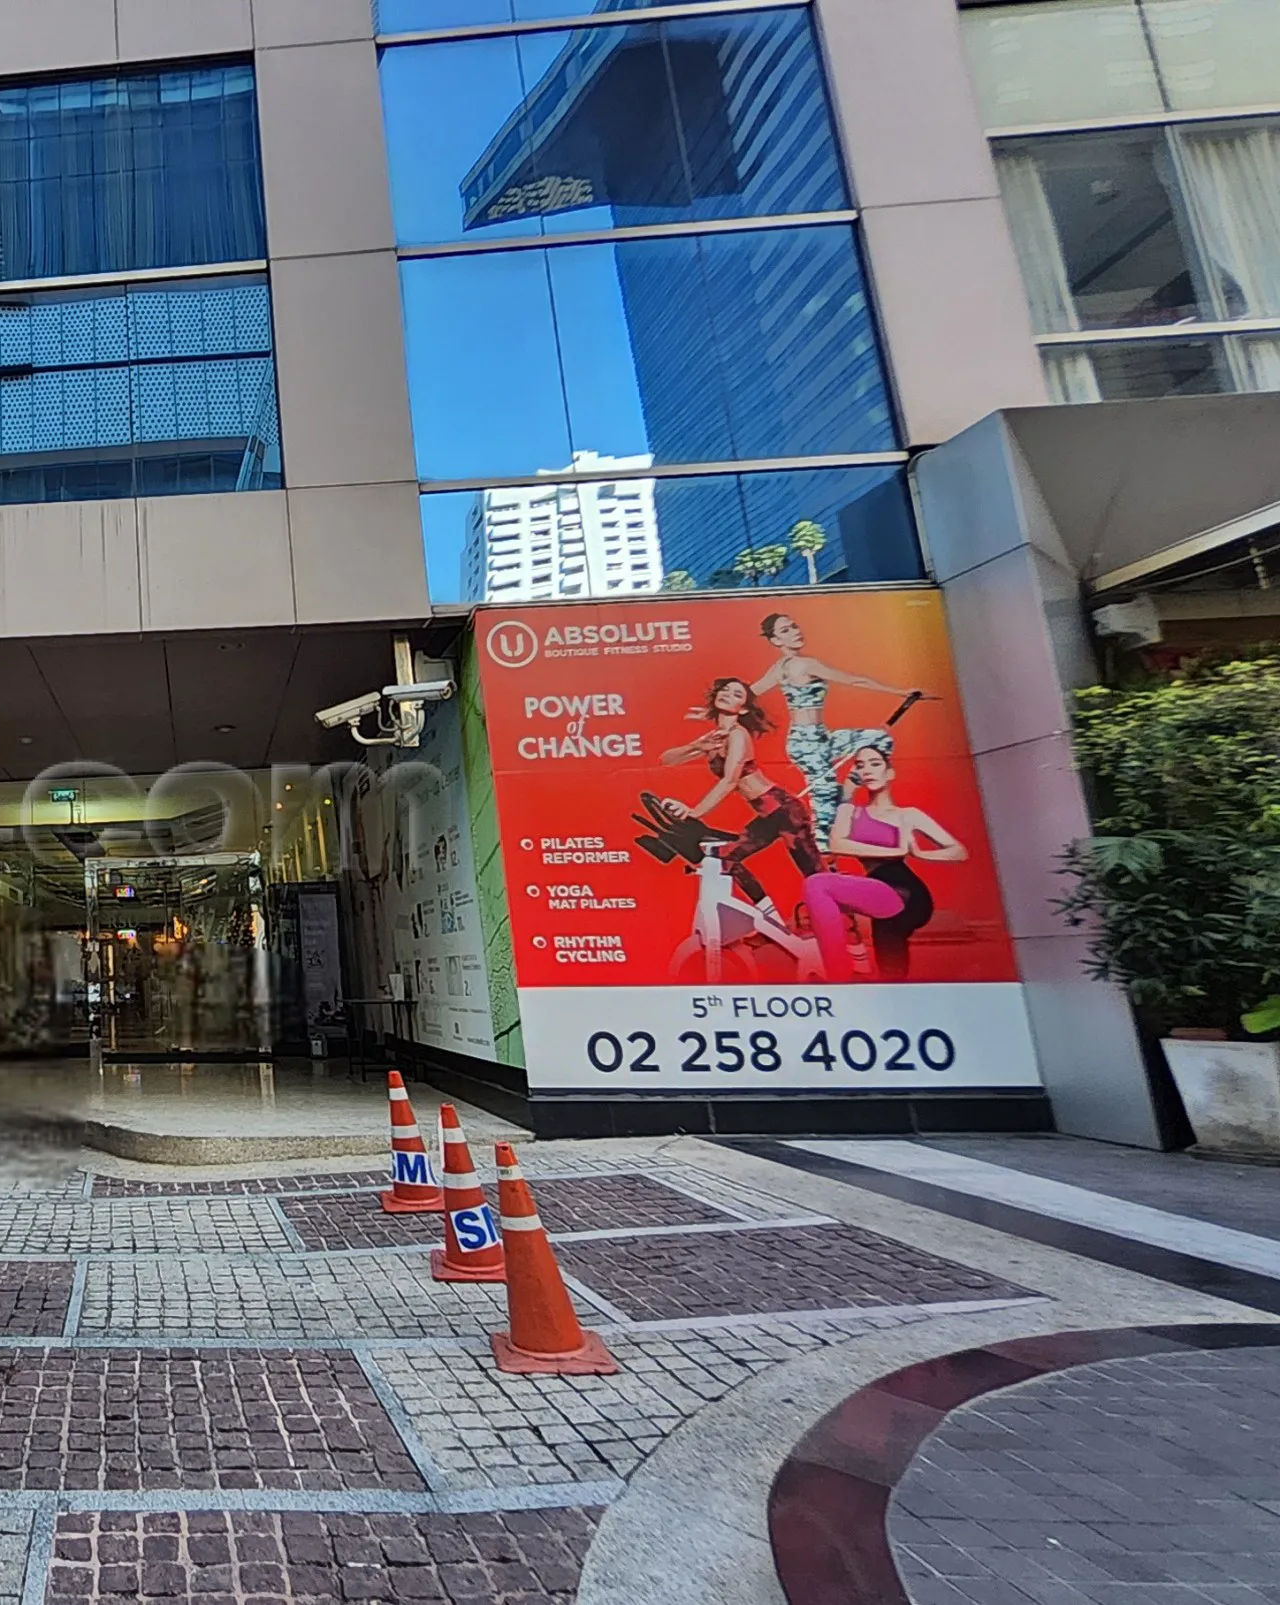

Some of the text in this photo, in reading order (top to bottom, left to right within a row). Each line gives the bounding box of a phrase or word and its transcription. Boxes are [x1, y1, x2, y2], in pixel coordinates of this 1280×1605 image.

[544, 620, 692, 646] ABSOLUTE
[544, 642, 693, 658] BOUTIQUE FITNESS STUDIO
[524, 693, 626, 718] POWER
[566, 713, 590, 740] of
[517, 733, 643, 760] CHANGE
[540, 837, 604, 850] PILATES
[542, 850, 631, 865] REFORMER
[546, 885, 594, 897] YOGA
[548, 897, 637, 910] MAT PILATES
[553, 935, 623, 949] RHYTHM
[555, 949, 627, 963] CYCLING
[691, 994, 837, 1019] 5th FLOOR
[586, 1028, 957, 1073] 02 258 4020
